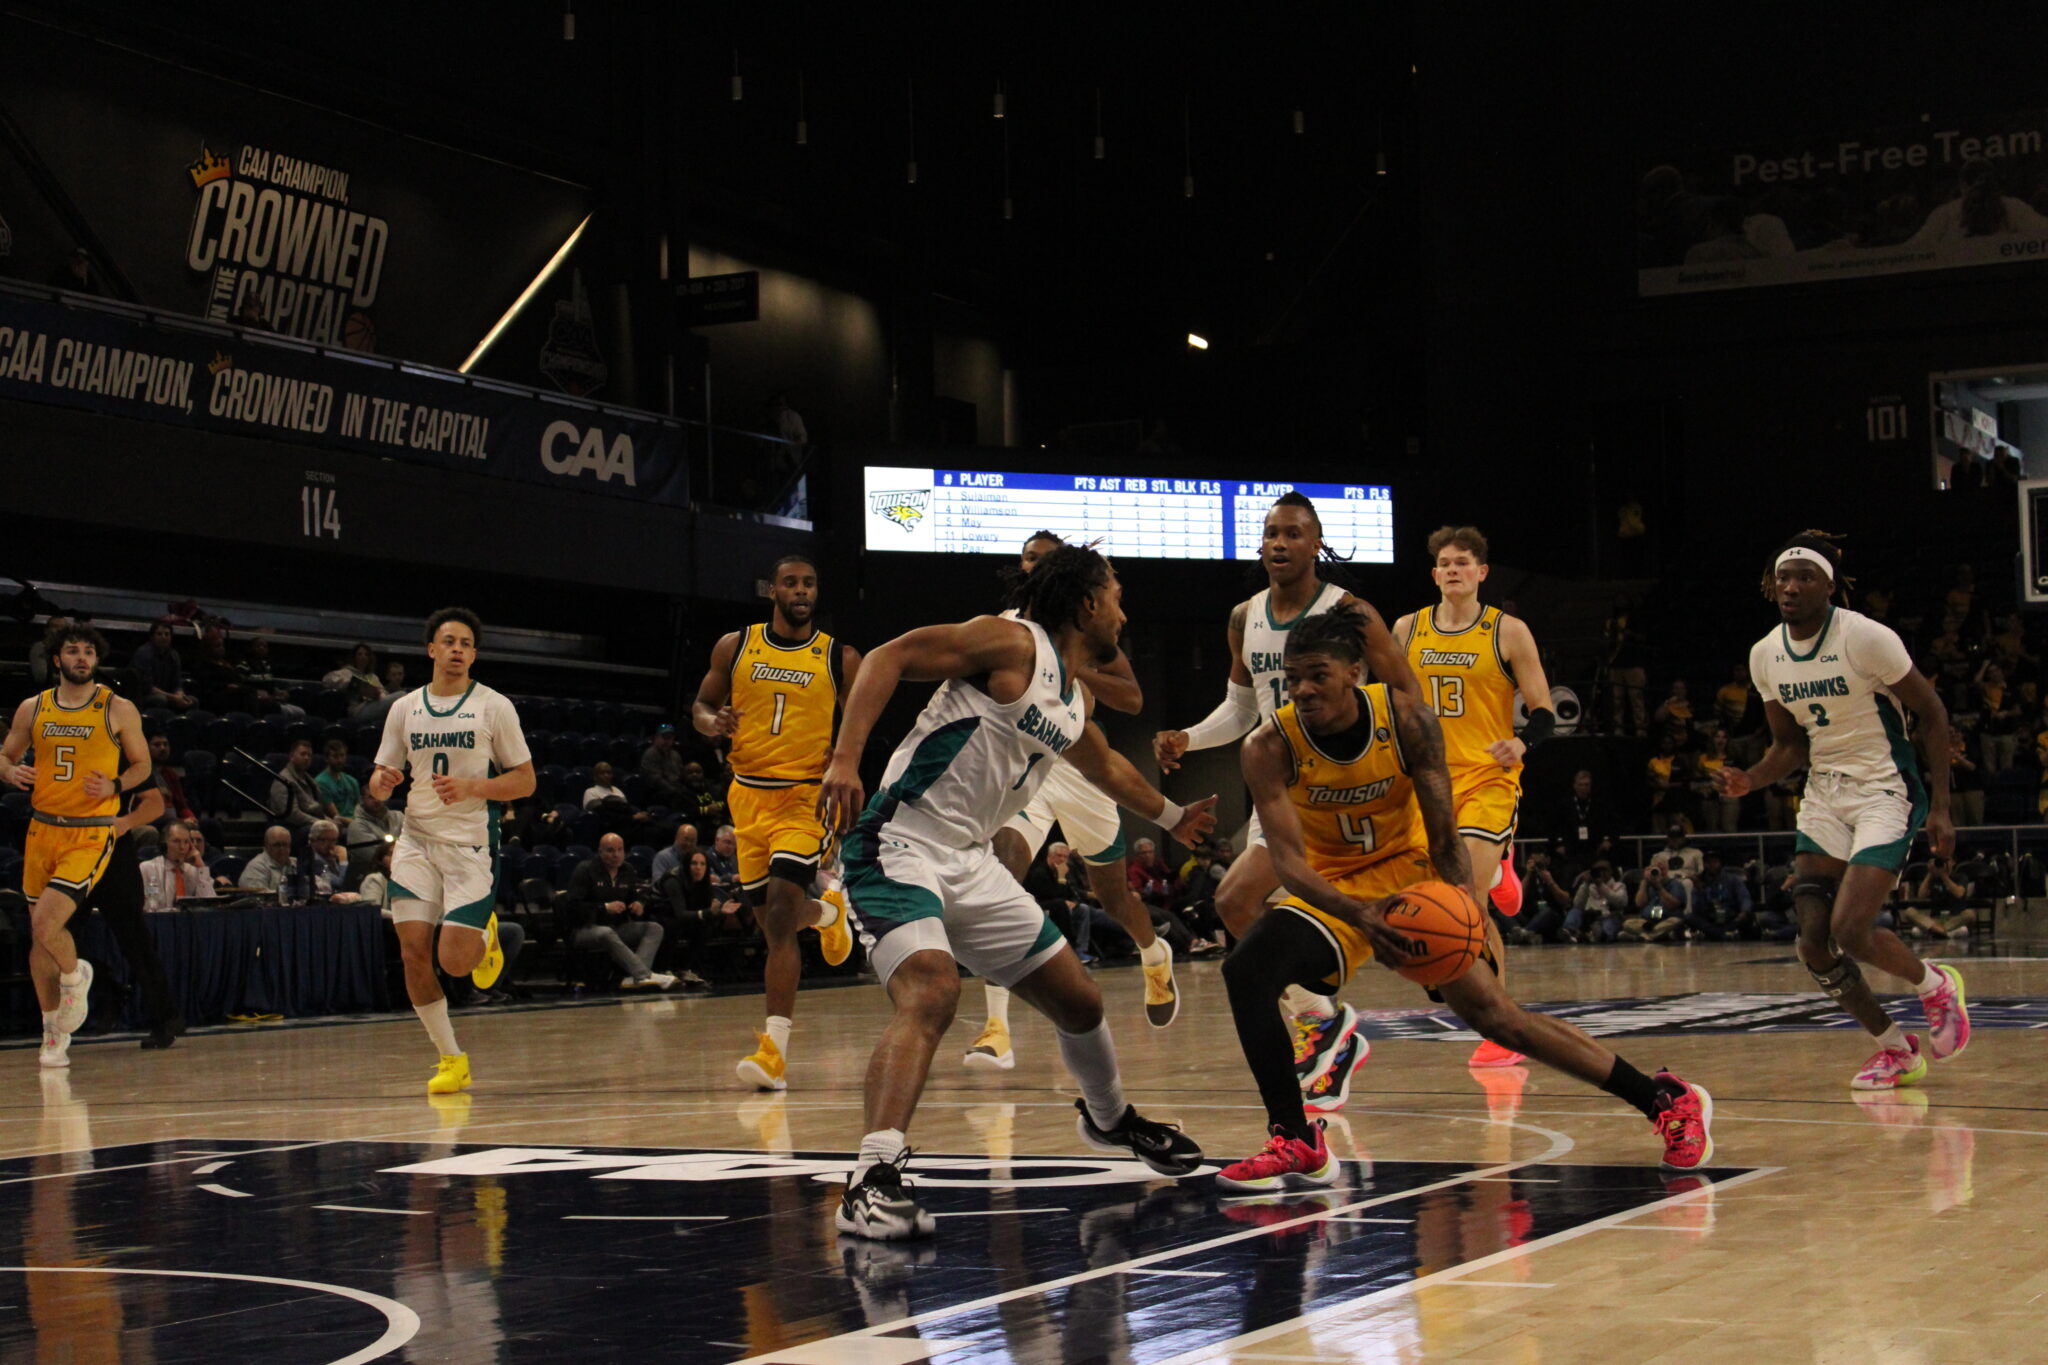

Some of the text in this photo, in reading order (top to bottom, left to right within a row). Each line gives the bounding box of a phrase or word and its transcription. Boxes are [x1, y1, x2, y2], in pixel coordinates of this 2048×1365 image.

[238, 145, 348, 206] CAA CHAMPION,
[1732, 141, 1928, 186] Pest-Free
[188, 179, 388, 309] CROWNED
[214, 266, 237, 300] THE
[51, 338, 195, 416] CHAMPION,
[208, 367, 334, 434] CROWNED
[340, 392, 368, 439] IN
[370, 397, 410, 446] THE
[410, 406, 488, 460] CAPITAL
[1866, 404, 1908, 442] 101
[540, 420, 636, 487] CAA
[306, 470, 336, 483] SECTION
[944, 473, 1220, 494] # PLAYER PTS AST REB STL BLK FLS
[868, 489, 932, 514] TOWSON
[1344, 488, 1364, 499] PTS
[1370, 488, 1388, 500] FLS
[301, 486, 341, 540] 114
[961, 518, 982, 529] May
[961, 532, 1000, 543] Lowery
[1251, 652, 1287, 674] SEAH
[1420, 648, 1480, 670] TOWSON
[1820, 654, 1838, 663] CAA
[752, 662, 816, 688] TOWSON
[1778, 675, 1850, 704] SEAHAWKS
[1428, 676, 1464, 718] 13
[770, 692, 786, 736] 1
[1016, 703, 1072, 756] SEAHAW
[42, 722, 95, 740] TOWSON
[410, 730, 475, 751] SEAHAWKS
[54, 745, 76, 781] 5
[1012, 752, 1044, 790] 1
[1306, 776, 1395, 805] TOWSON
[1336, 813, 1376, 854] 4
